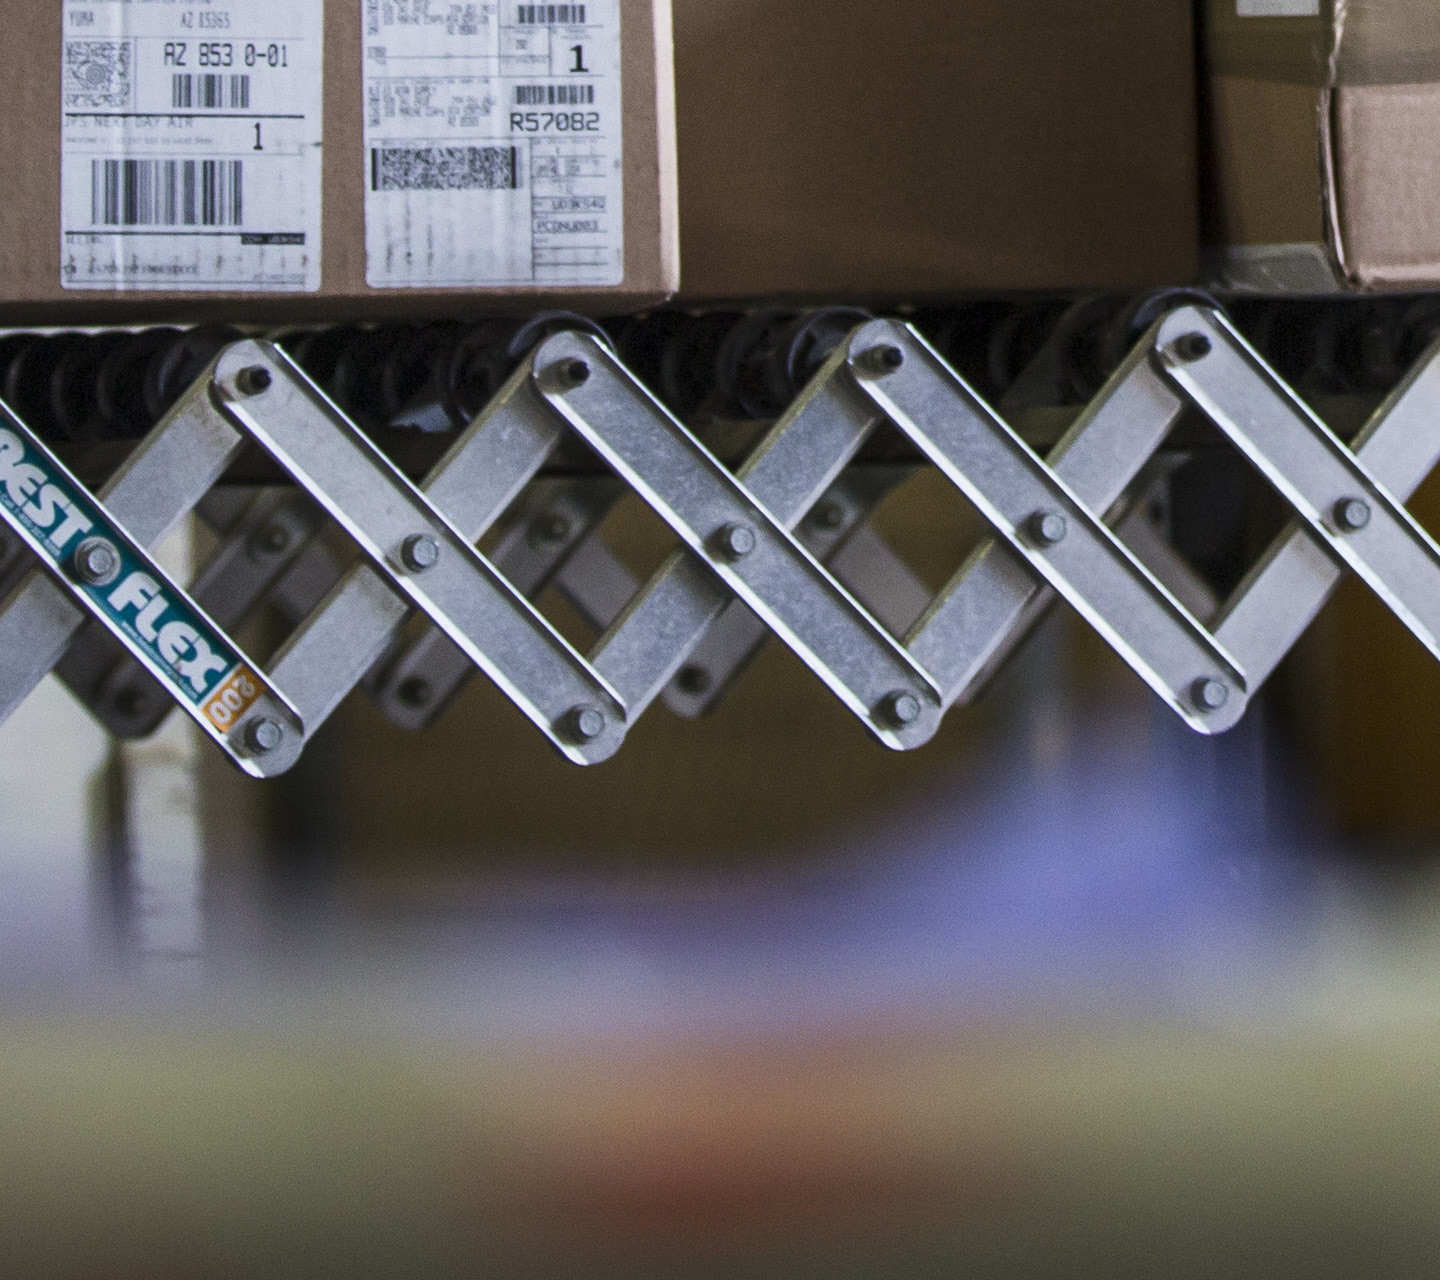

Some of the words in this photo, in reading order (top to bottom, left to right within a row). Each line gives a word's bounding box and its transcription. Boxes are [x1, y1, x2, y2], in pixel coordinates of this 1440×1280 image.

[163, 42, 187, 67] AZ
[198, 42, 233, 68] 853
[244, 43, 288, 68] 0-01
[568, 44, 590, 74] 1
[252, 121, 264, 151] 1
[509, 111, 601, 133] R57082
[107, 570, 229, 694] FLEX
[209, 674, 256, 725] 200
